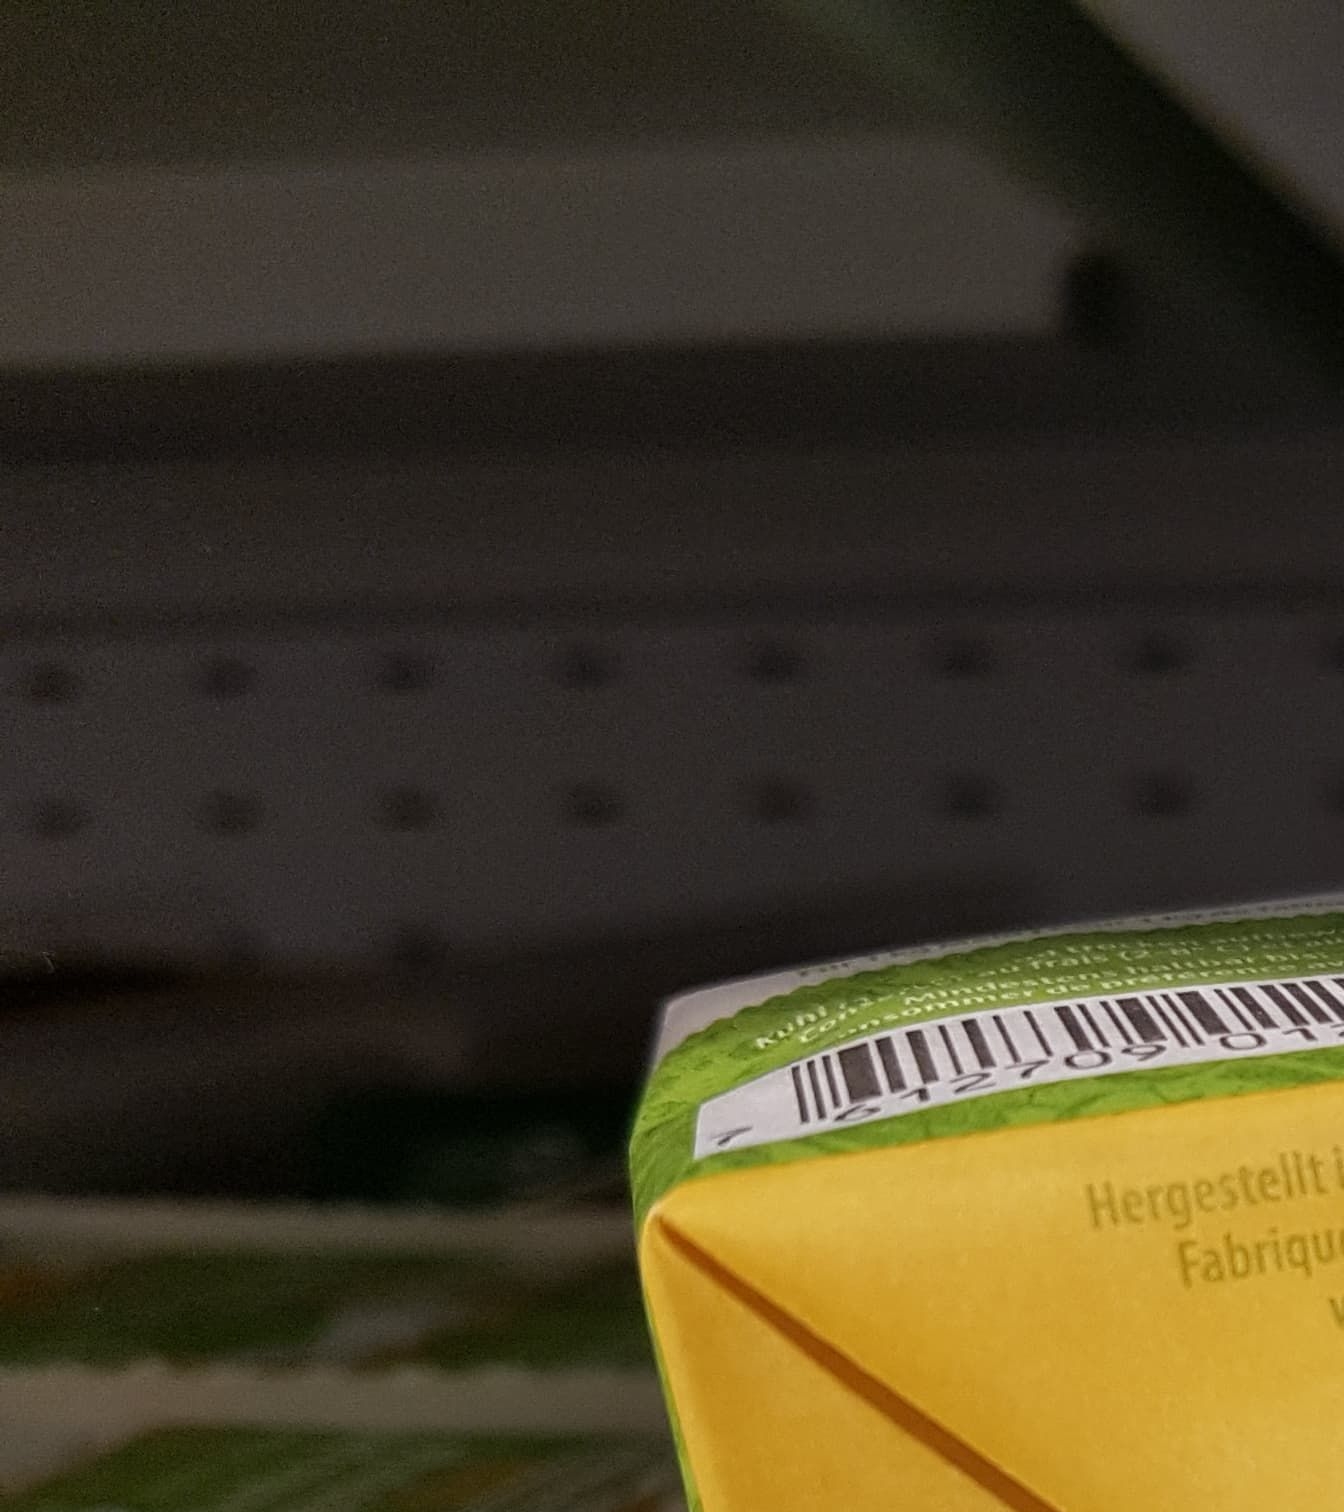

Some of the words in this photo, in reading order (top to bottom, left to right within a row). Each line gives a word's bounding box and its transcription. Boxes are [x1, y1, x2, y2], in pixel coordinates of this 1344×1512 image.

[904, 971, 1118, 1006] Mindestens
[832, 1044, 1168, 1123] 612709
[1083, 1149, 1328, 1231] Hergestellt
